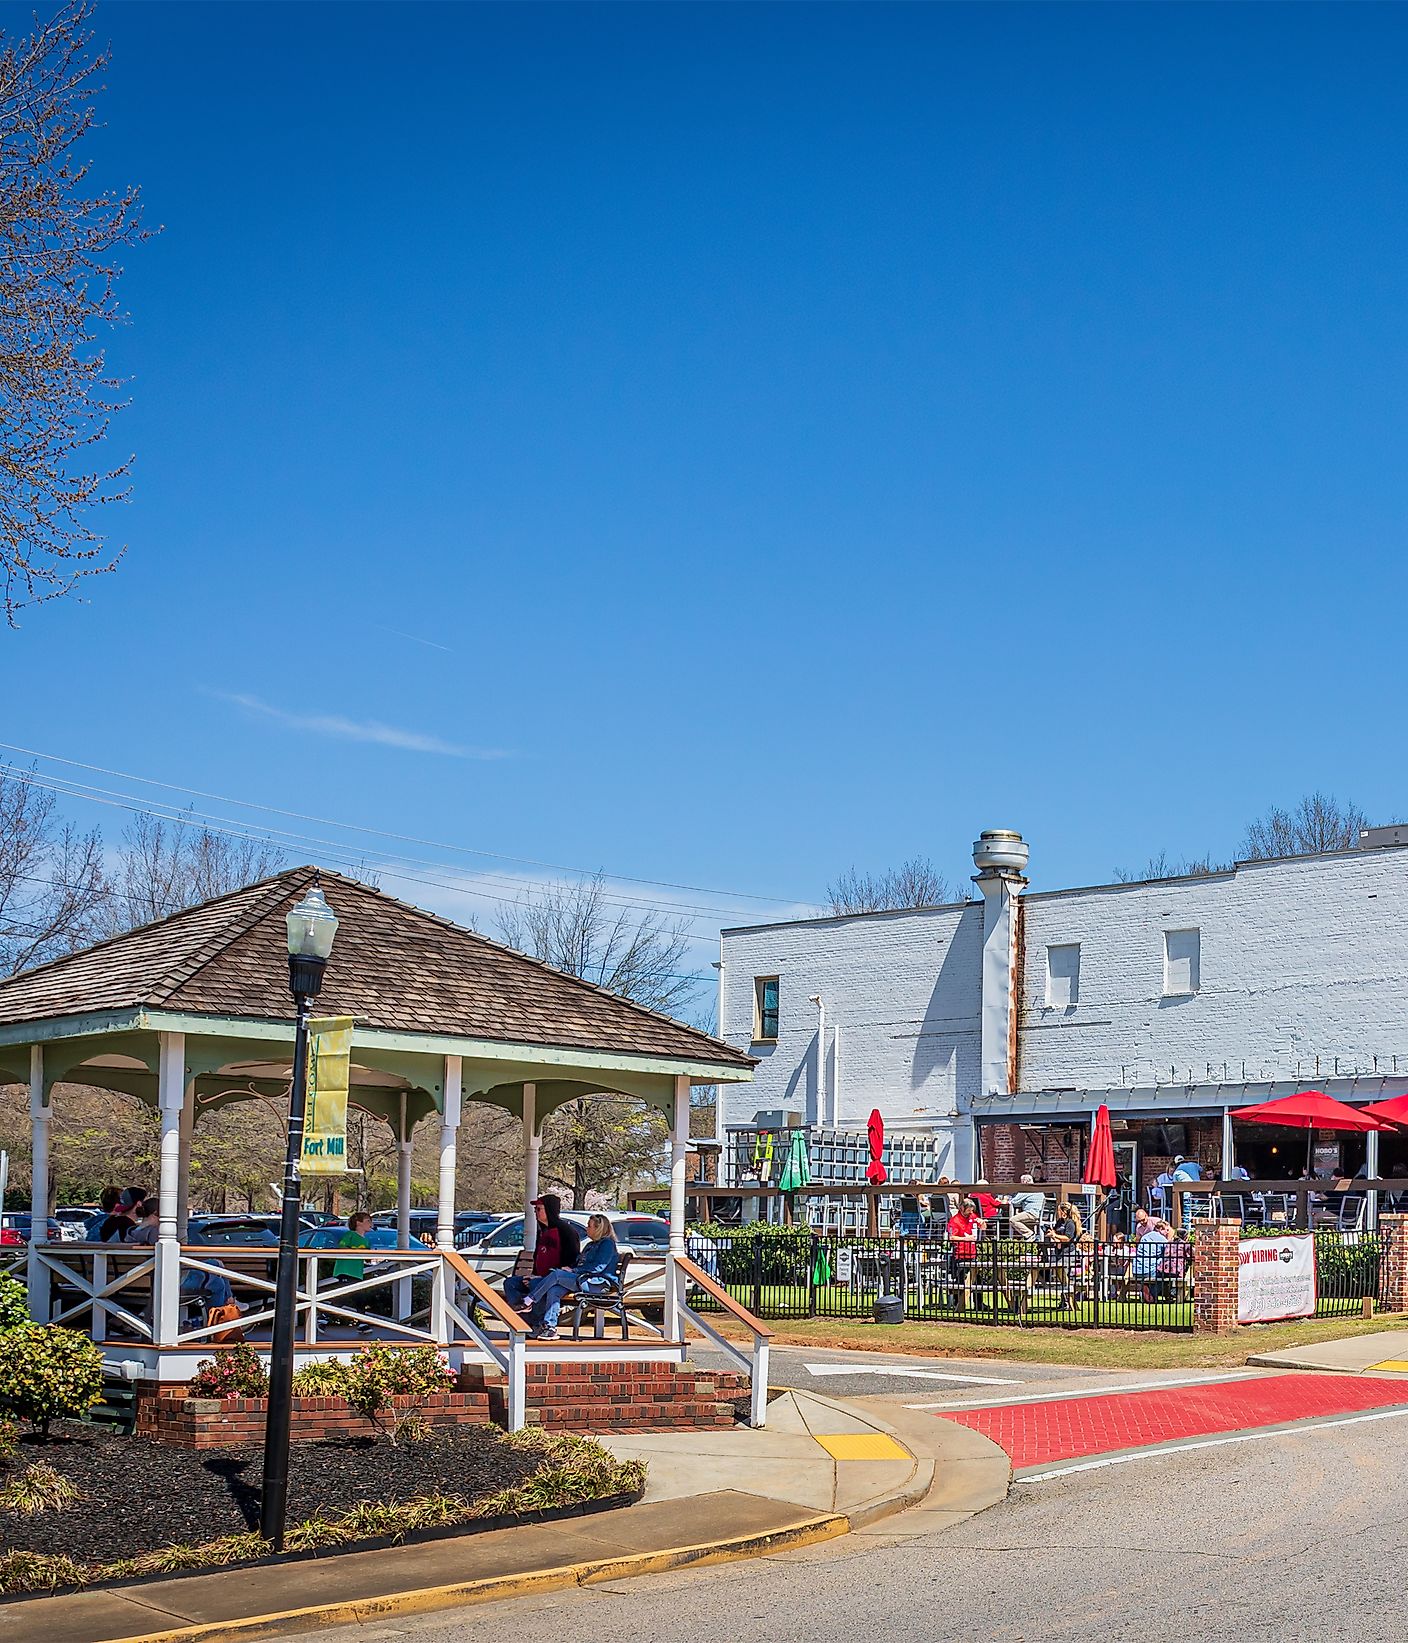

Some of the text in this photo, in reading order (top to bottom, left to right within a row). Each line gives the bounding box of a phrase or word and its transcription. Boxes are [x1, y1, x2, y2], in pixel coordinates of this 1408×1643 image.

[303, 1136, 344, 1156] Fort Mill
[1252, 1249, 1278, 1263] HIRING
